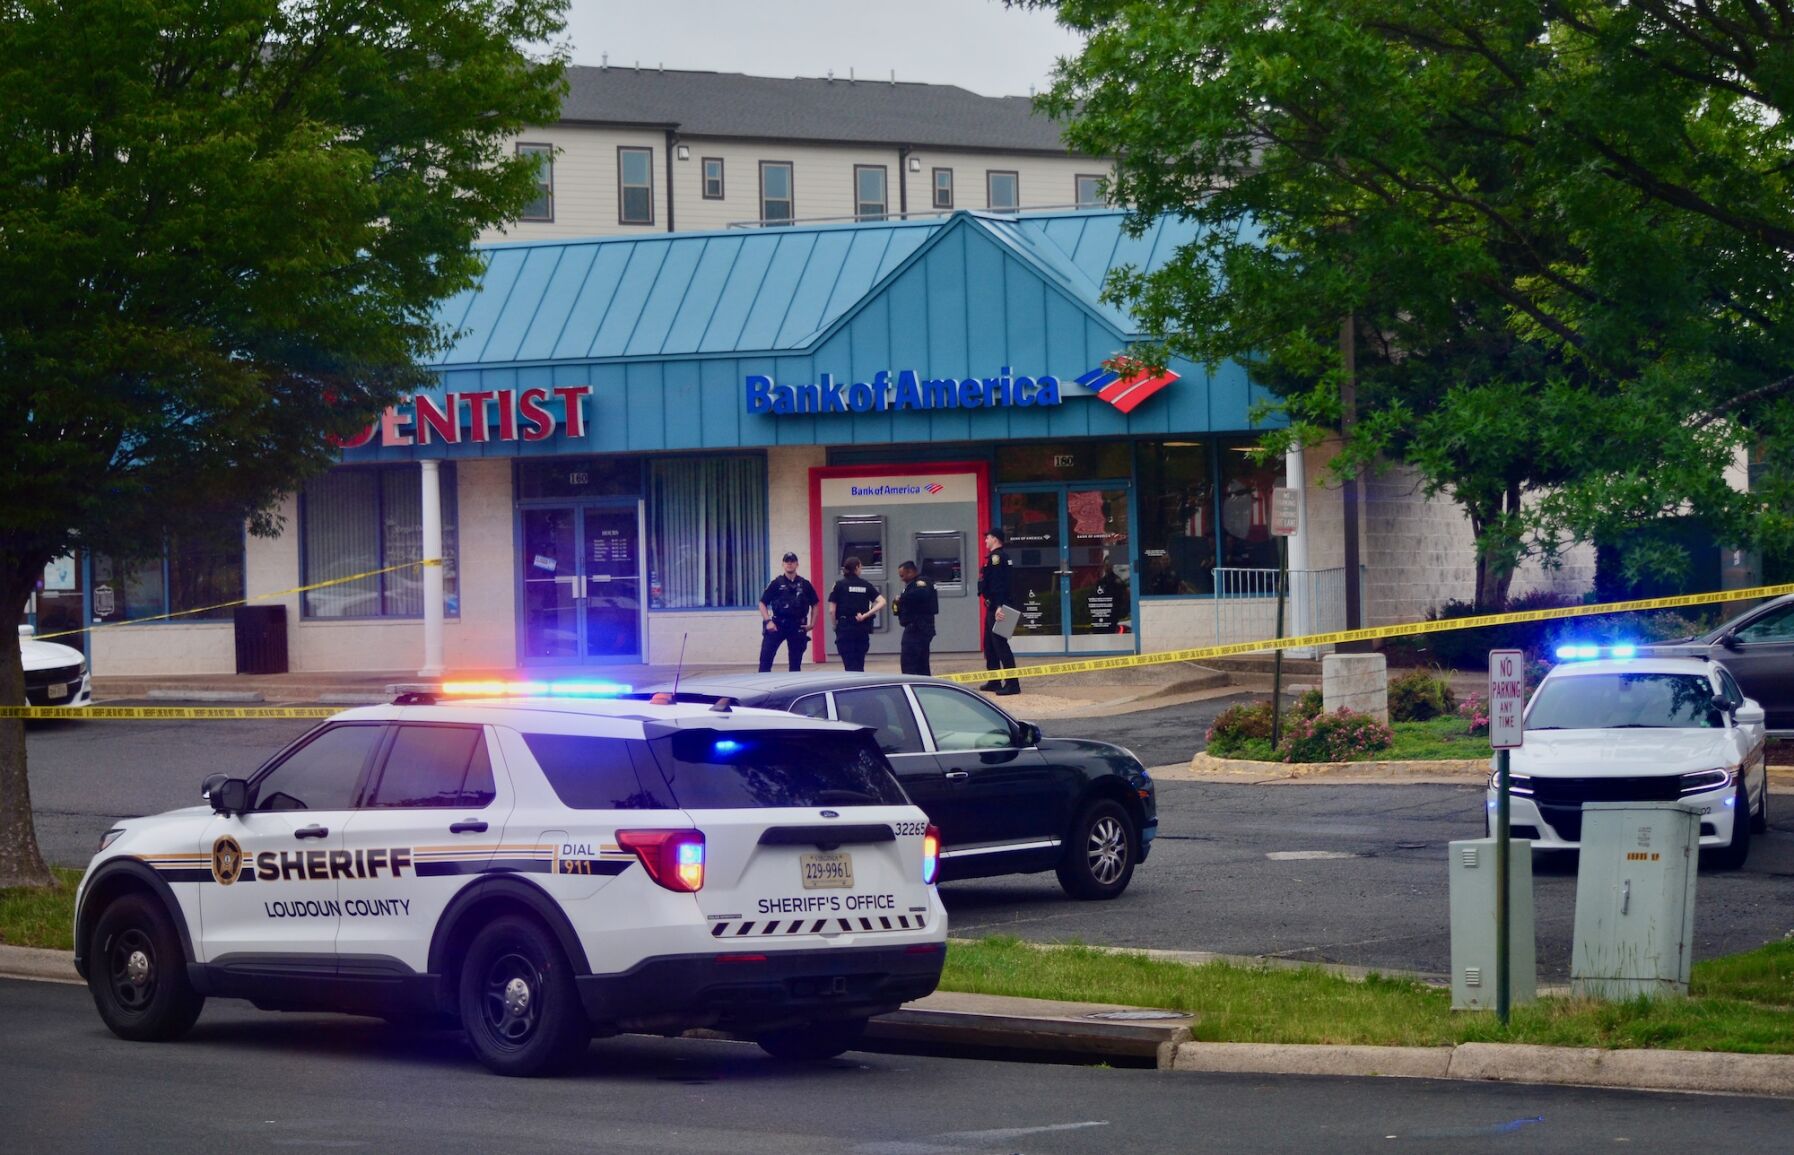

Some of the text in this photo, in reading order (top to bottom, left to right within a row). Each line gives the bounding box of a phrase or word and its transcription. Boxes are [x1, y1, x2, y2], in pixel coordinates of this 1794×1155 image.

[746, 366, 1063, 415] Bank of America
[1055, 456, 1073, 466] 180
[851, 484, 921, 496] Bank of America
[1500, 660, 1512, 677] NO
[1492, 681, 1520, 699] PARKING
[1500, 702, 1512, 713] ANY
[1499, 716, 1514, 728] TIME
[895, 822, 925, 836] 32265
[562, 844, 595, 855] DIAL
[257, 848, 411, 881] SHERIFF
[564, 860, 591, 874] 911
[264, 899, 410, 918] LOUDOUN COUNTY
[758, 894, 895, 914] SHERIFF'S OFFICE
